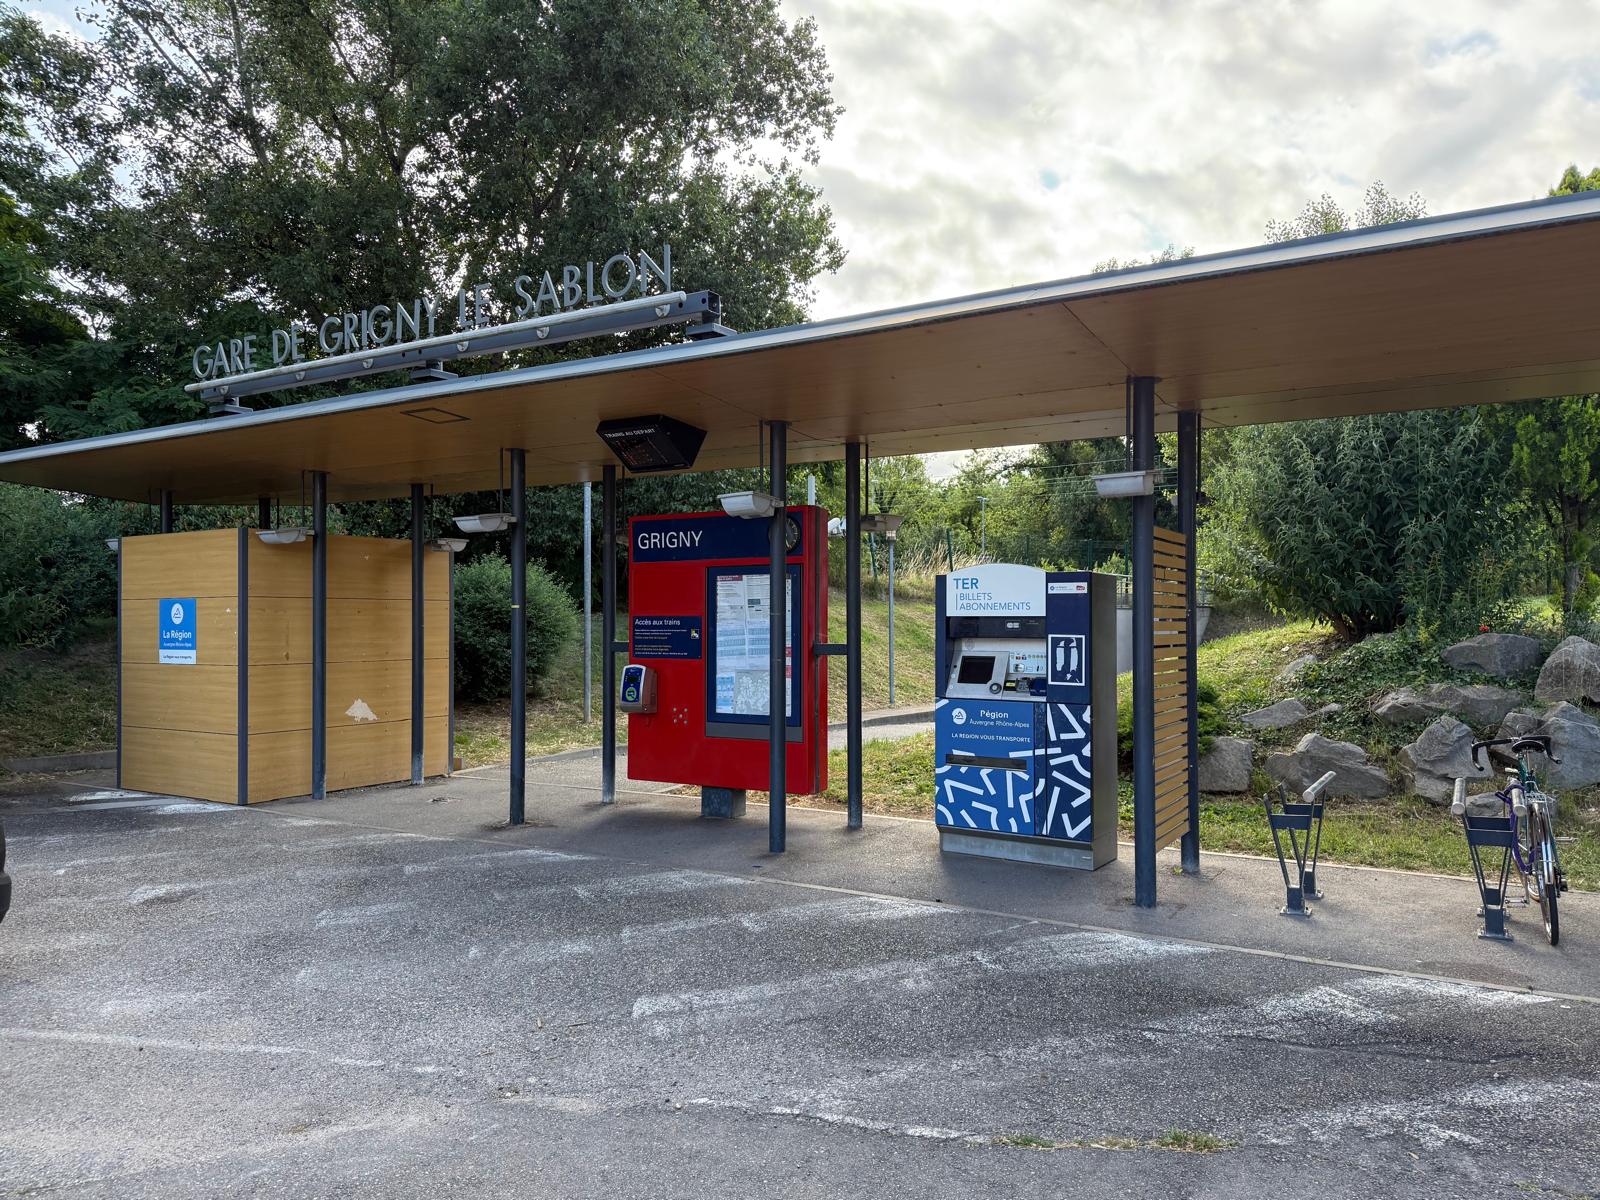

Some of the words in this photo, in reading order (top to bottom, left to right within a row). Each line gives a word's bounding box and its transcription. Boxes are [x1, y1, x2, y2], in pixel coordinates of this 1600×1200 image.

[193, 335, 257, 379] GARE
[272, 324, 305, 364] DE
[320, 294, 441, 353] GRIGNY
[459, 283, 491, 328] LE
[515, 243, 671, 316] SABLON
[638, 530, 703, 549] GRIGNY
[953, 578, 979, 590] TER
[960, 593, 993, 601] BILLETS
[960, 602, 1031, 611] ABONNEMENTS
[634, 618, 652, 626] Accès
[162, 630, 170, 639] La
[171, 630, 192, 641] Région
[996, 735, 1031, 743] TRANSPORTE
